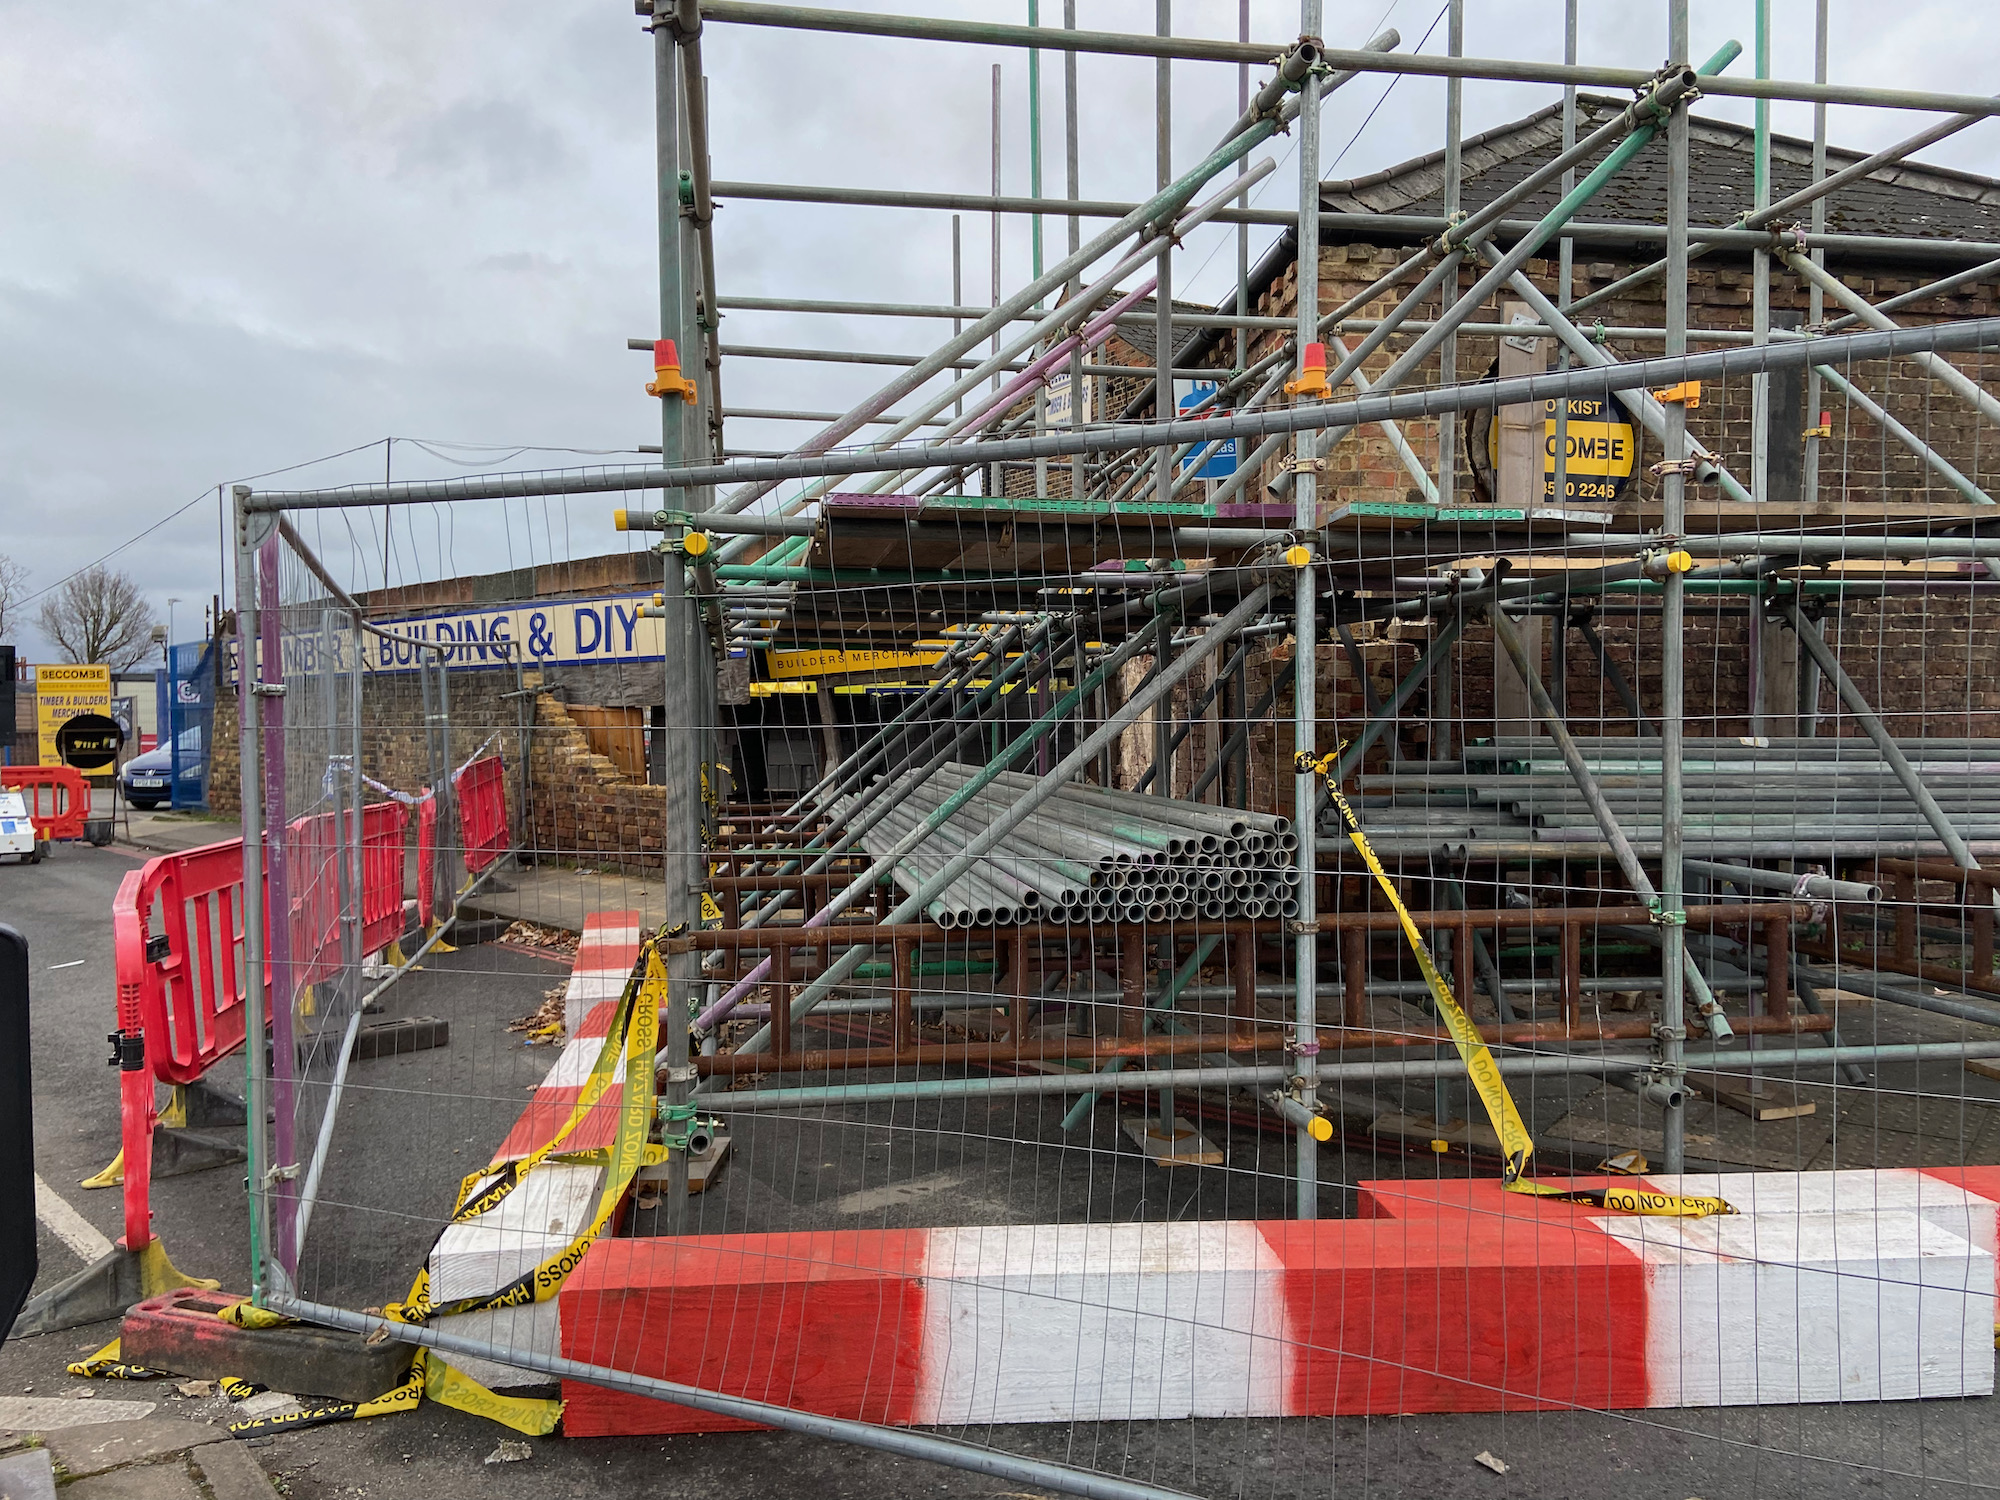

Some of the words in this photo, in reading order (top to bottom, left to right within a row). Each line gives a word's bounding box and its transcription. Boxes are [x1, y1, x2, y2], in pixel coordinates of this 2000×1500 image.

[1545, 435, 1624, 461] COMBE
[1579, 482, 1616, 499] 2246
[528, 612, 555, 657] &
[575, 602, 645, 654] DIY
[777, 654, 845, 670] BUILDERS
[41, 670, 104, 679] SECCOMBE
[40, 696, 64, 706] TIMBER
[66, 696, 71, 706] &
[73, 695, 108, 706] BUILDERS
[457, 1181, 514, 1222] HAZAR
[1608, 1195, 1636, 1211] DO
[1639, 1194, 1676, 1210] NOT
[536, 1240, 591, 1289] CROSS
